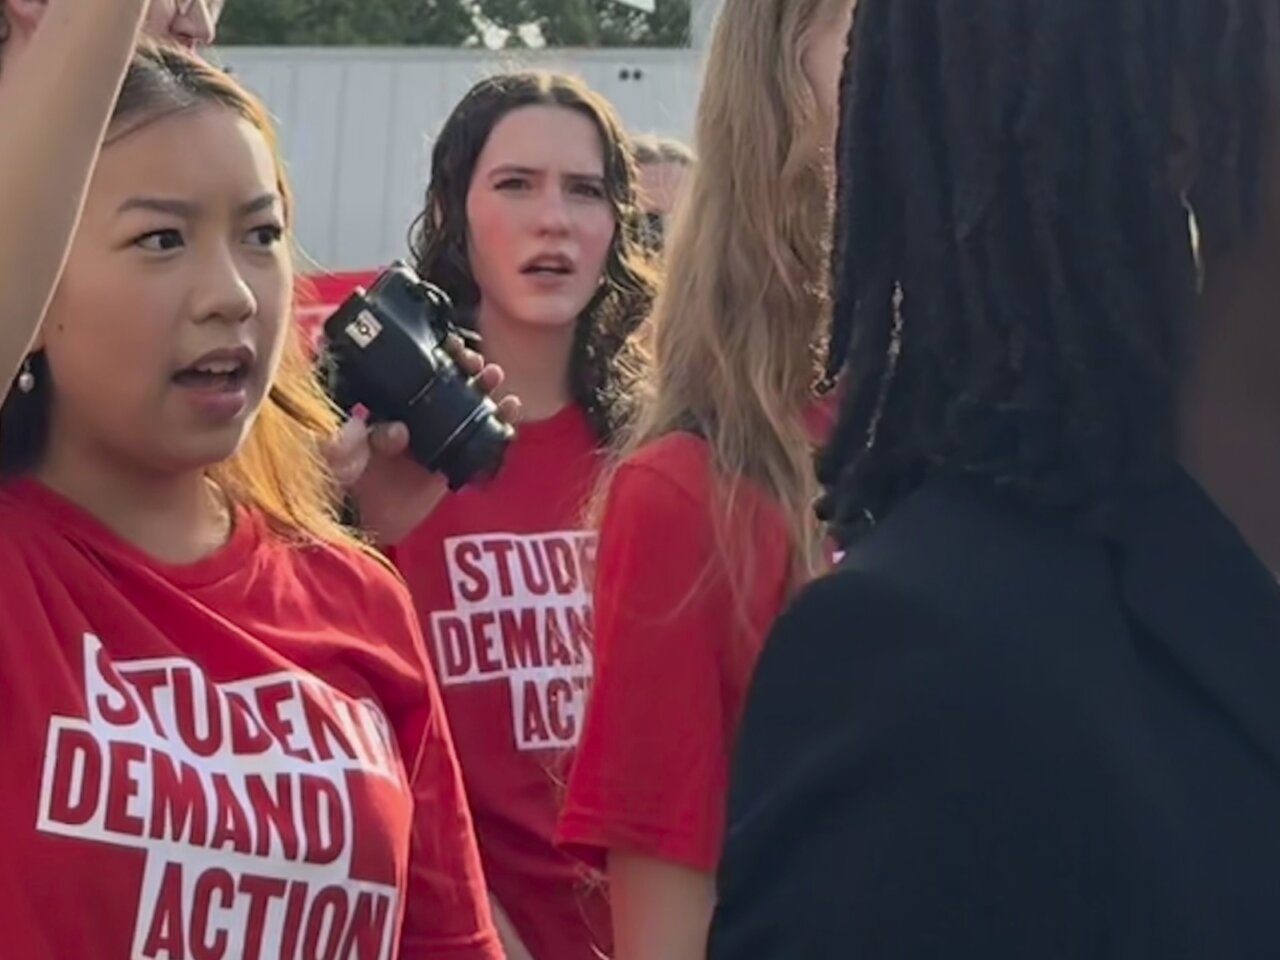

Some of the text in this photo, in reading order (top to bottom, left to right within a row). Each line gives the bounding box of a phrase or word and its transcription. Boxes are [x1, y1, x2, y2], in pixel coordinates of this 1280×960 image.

[454, 537, 591, 602] STUD
[47, 727, 345, 865] DEMAND
[142, 861, 391, 960] ACTION
